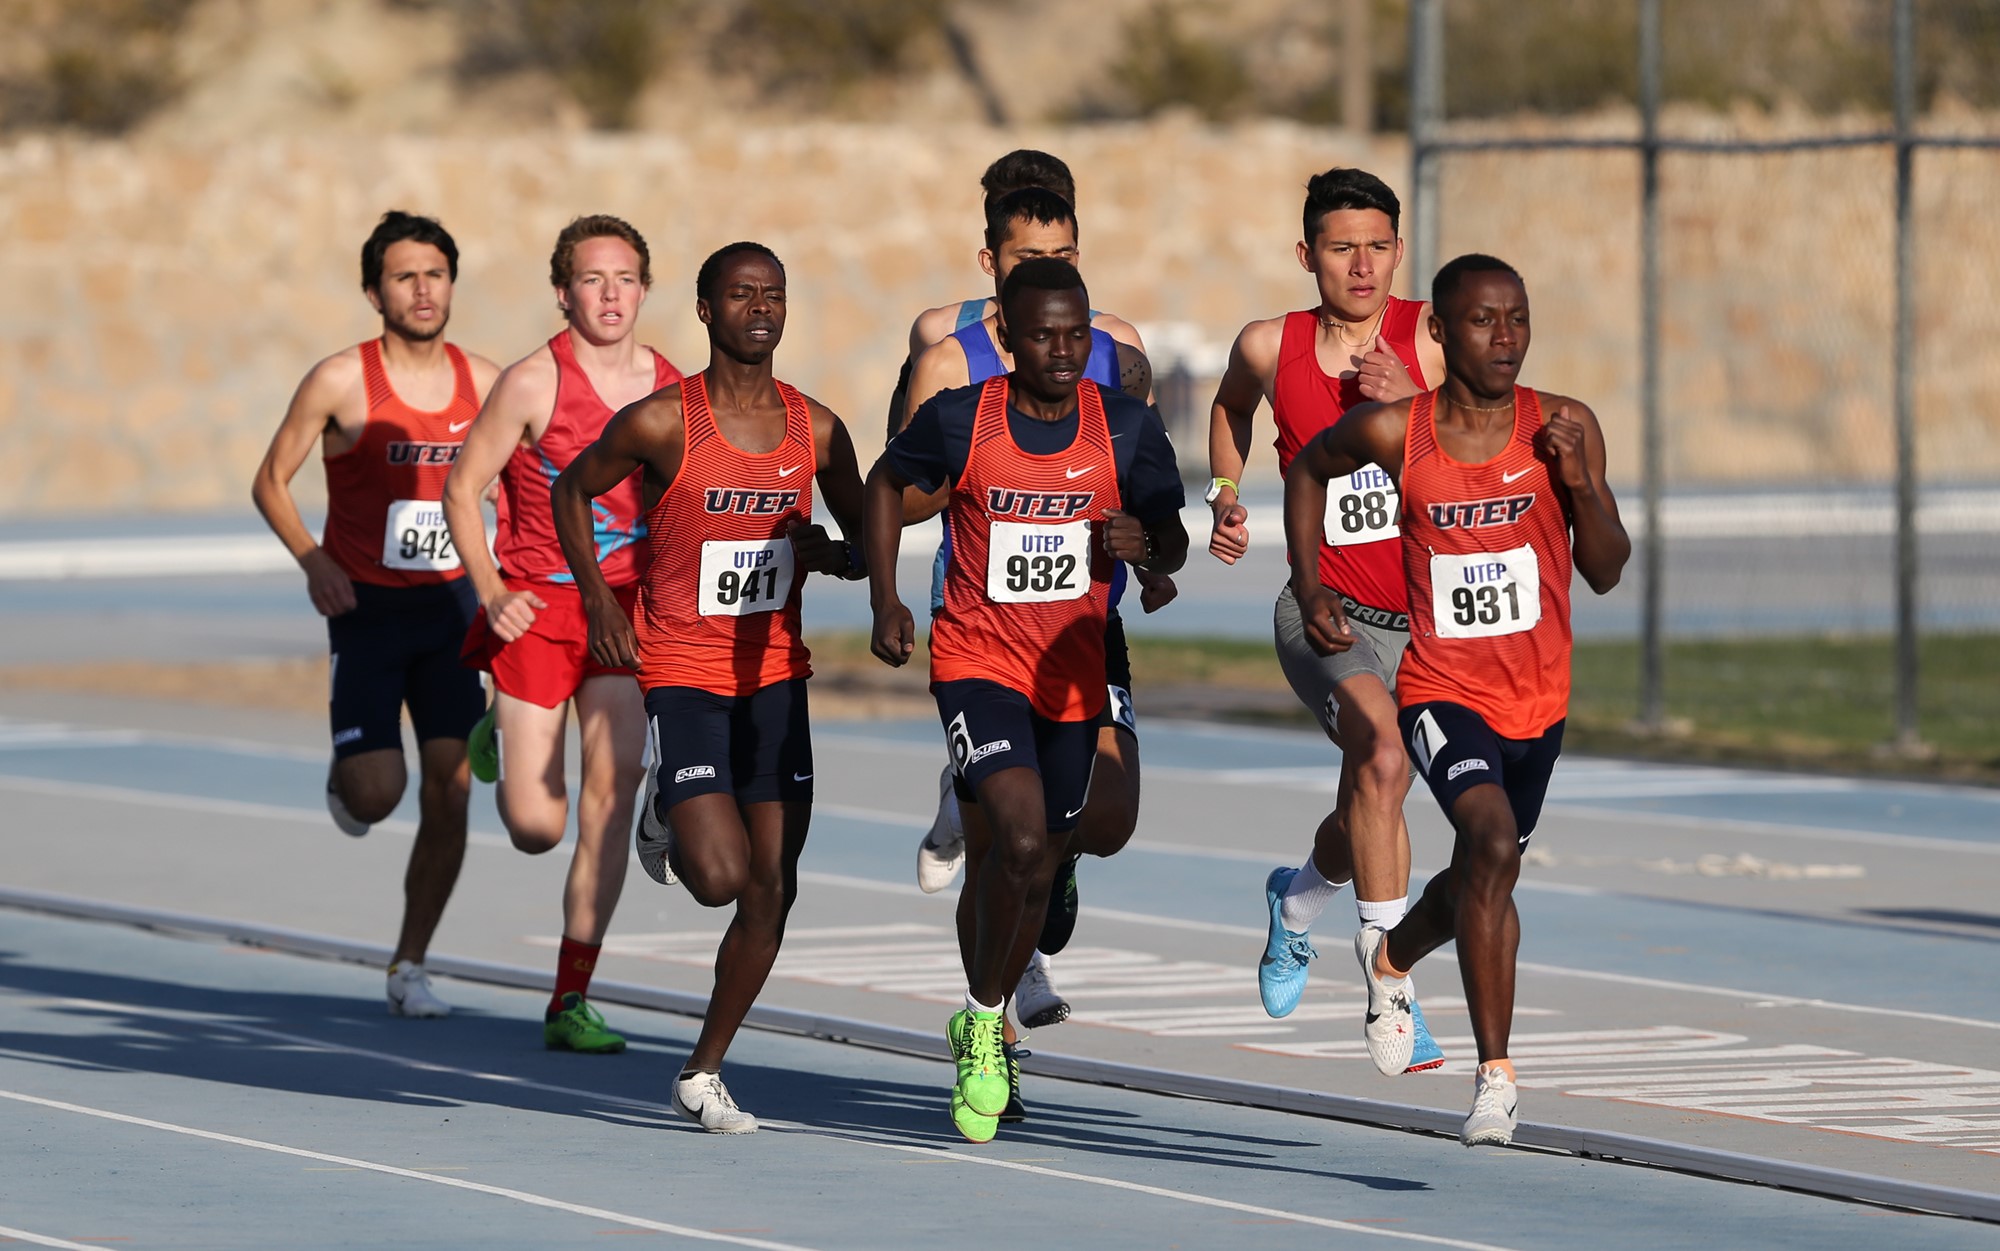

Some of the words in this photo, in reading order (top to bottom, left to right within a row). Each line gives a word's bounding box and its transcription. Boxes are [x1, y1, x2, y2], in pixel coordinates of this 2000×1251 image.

[704, 487, 801, 514] UTEP
[987, 486, 1095, 518] UTEP
[1428, 492, 1536, 529] UTEP
[399, 528, 451, 560] 942
[734, 550, 774, 568] UTEP
[1022, 535, 1064, 552] UTEP
[717, 567, 778, 605] 941
[1006, 554, 1076, 592] 932
[1463, 563, 1507, 584] UTEP
[1341, 597, 1392, 625] PRO
[1452, 582, 1520, 626] 931
[948, 722, 968, 769] 6
